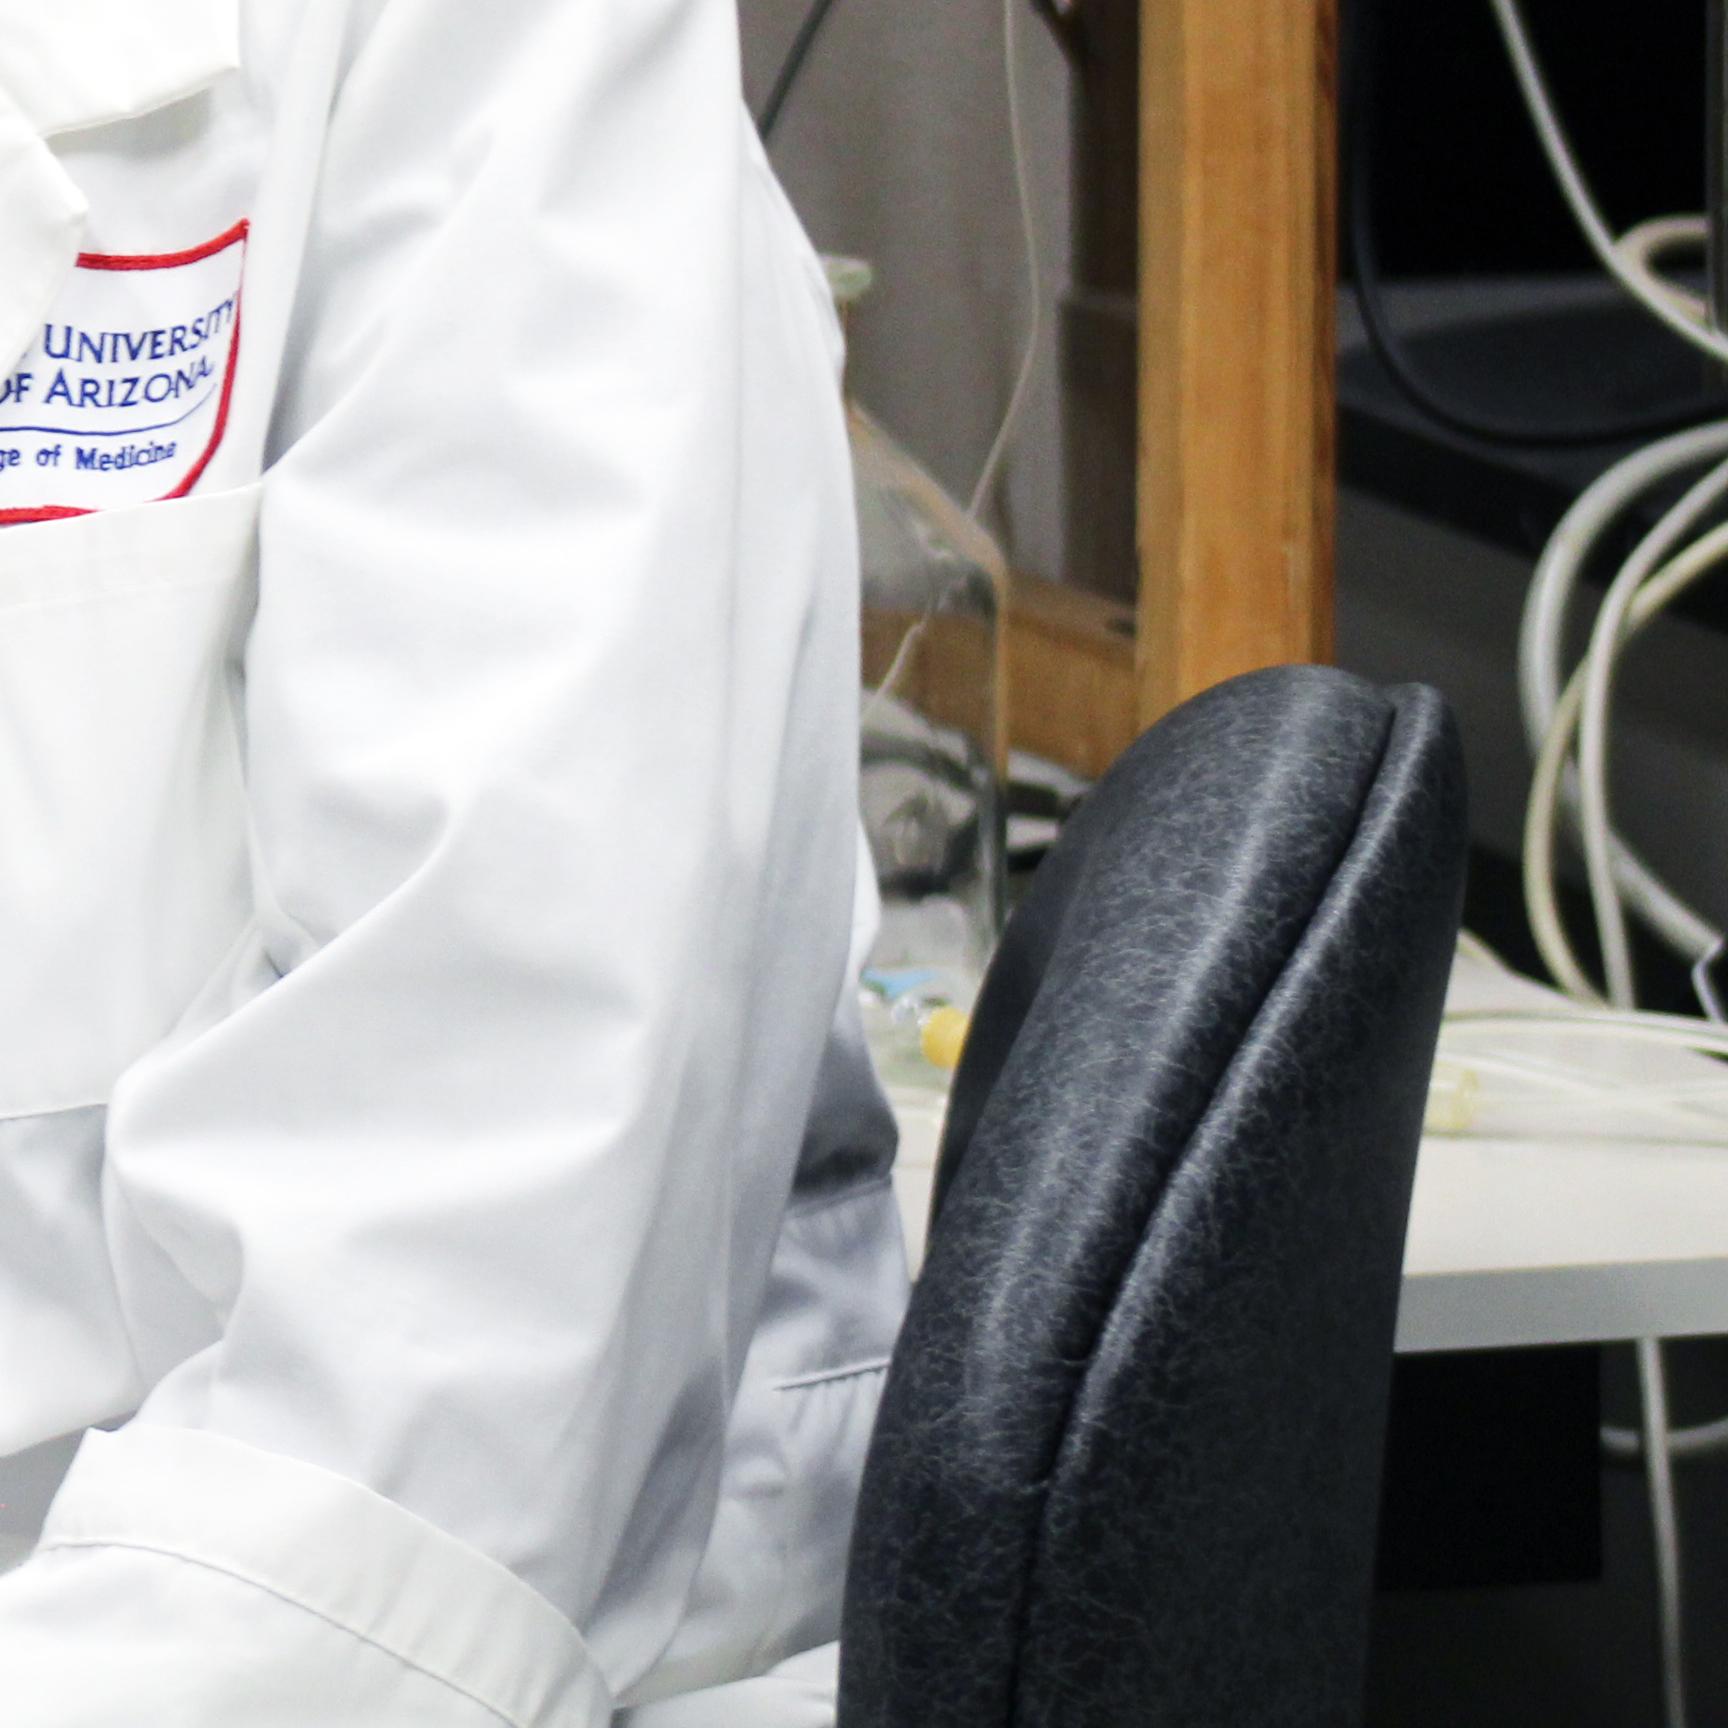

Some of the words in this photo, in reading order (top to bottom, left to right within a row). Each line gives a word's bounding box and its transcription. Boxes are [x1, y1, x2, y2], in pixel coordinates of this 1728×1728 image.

[45, 291, 236, 363] UNIVERSITY
[43, 357, 215, 408] ARIZONA
[35, 444, 62, 467] of
[76, 440, 177, 472] Medicine
